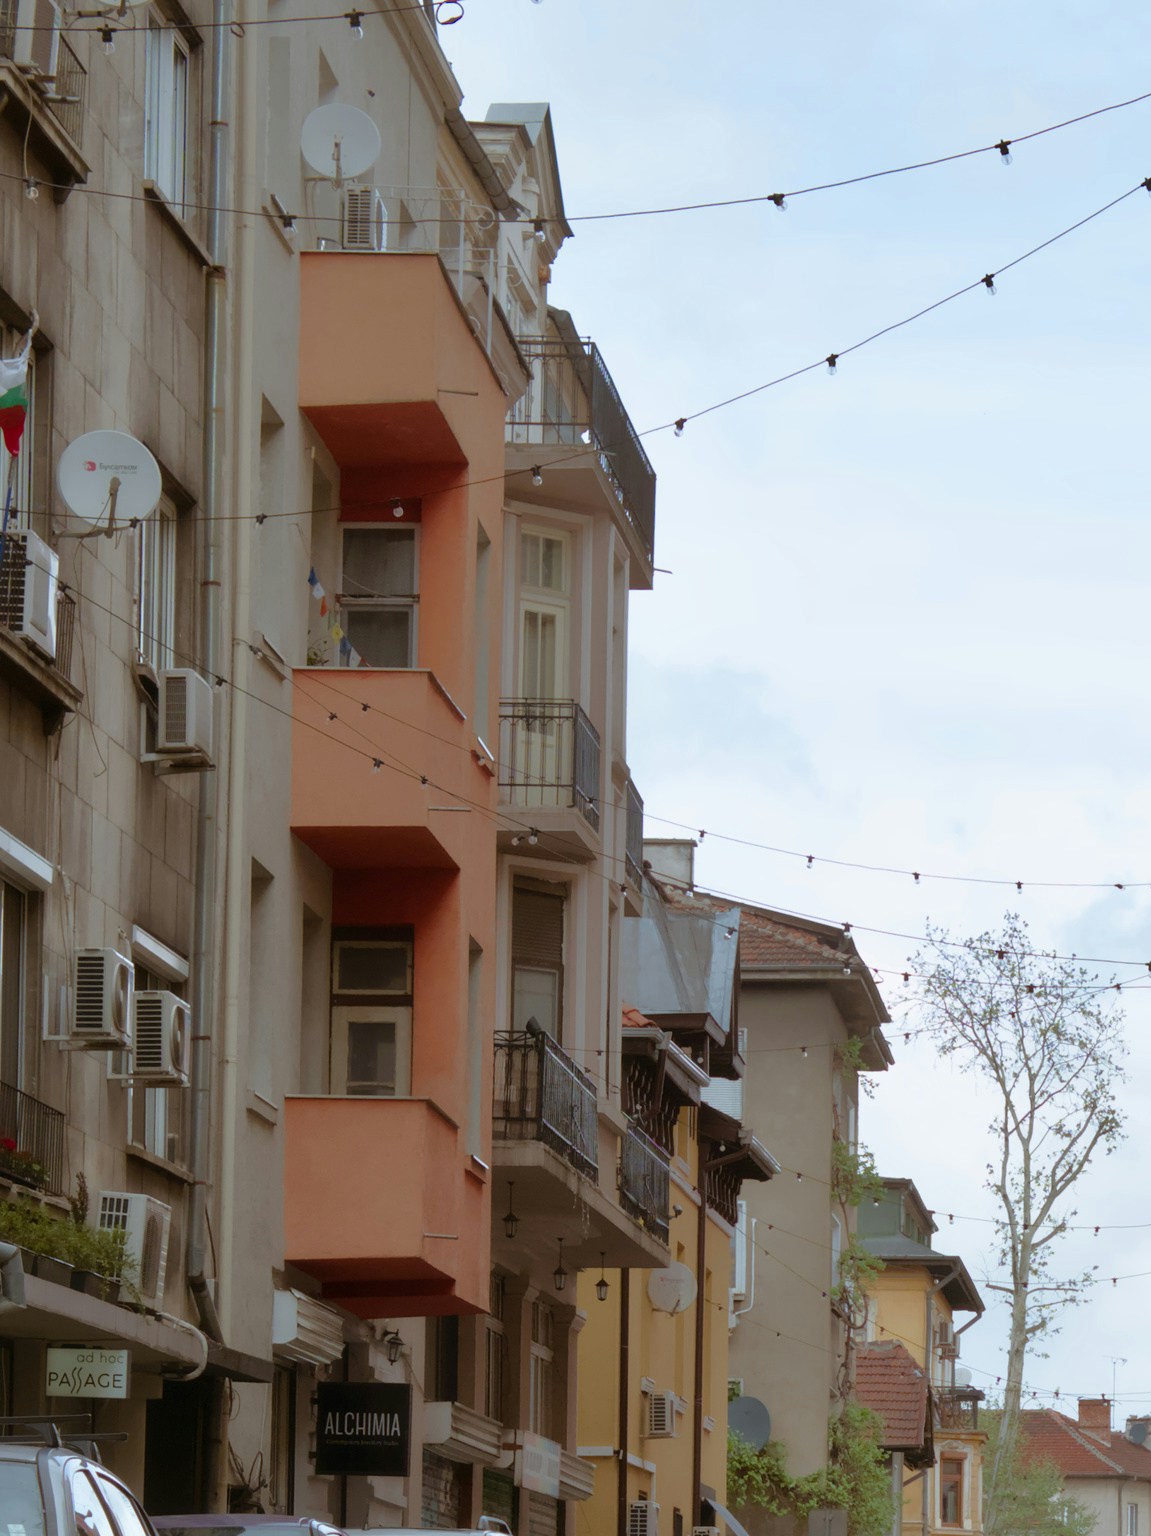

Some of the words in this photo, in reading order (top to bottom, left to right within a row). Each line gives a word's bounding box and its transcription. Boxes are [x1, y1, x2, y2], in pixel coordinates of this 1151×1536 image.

[76, 1352, 94, 1363] ad
[99, 1352, 124, 1364] hoc
[47, 1366, 123, 1395] PASSAGE
[324, 1411, 401, 1437] ALCHIMIA
